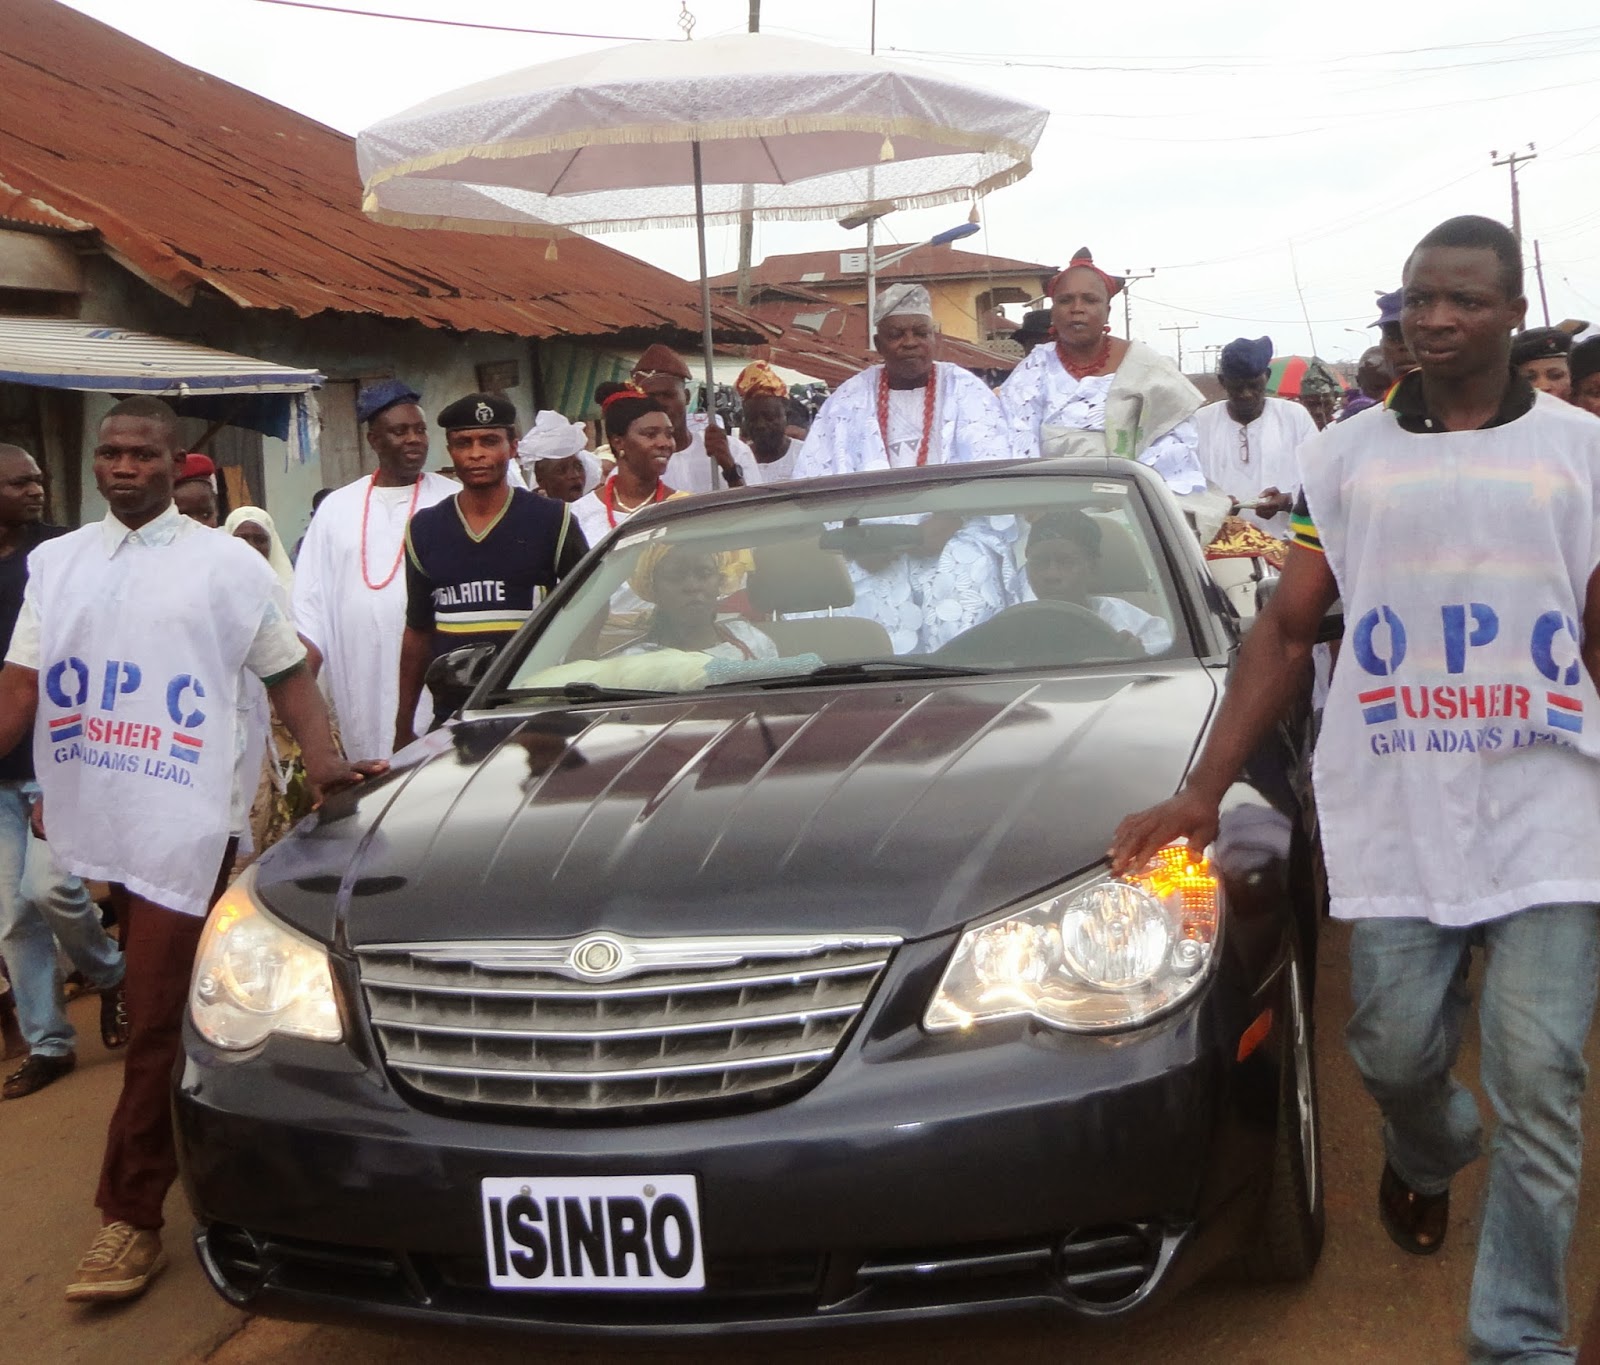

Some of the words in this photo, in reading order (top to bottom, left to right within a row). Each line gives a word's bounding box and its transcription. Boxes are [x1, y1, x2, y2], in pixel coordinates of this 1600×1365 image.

[1401, 684, 1531, 720] USHER
[85, 716, 162, 751] SHER
[144, 757, 195, 788] LEAD.
[488, 1193, 695, 1280] ISINRO
